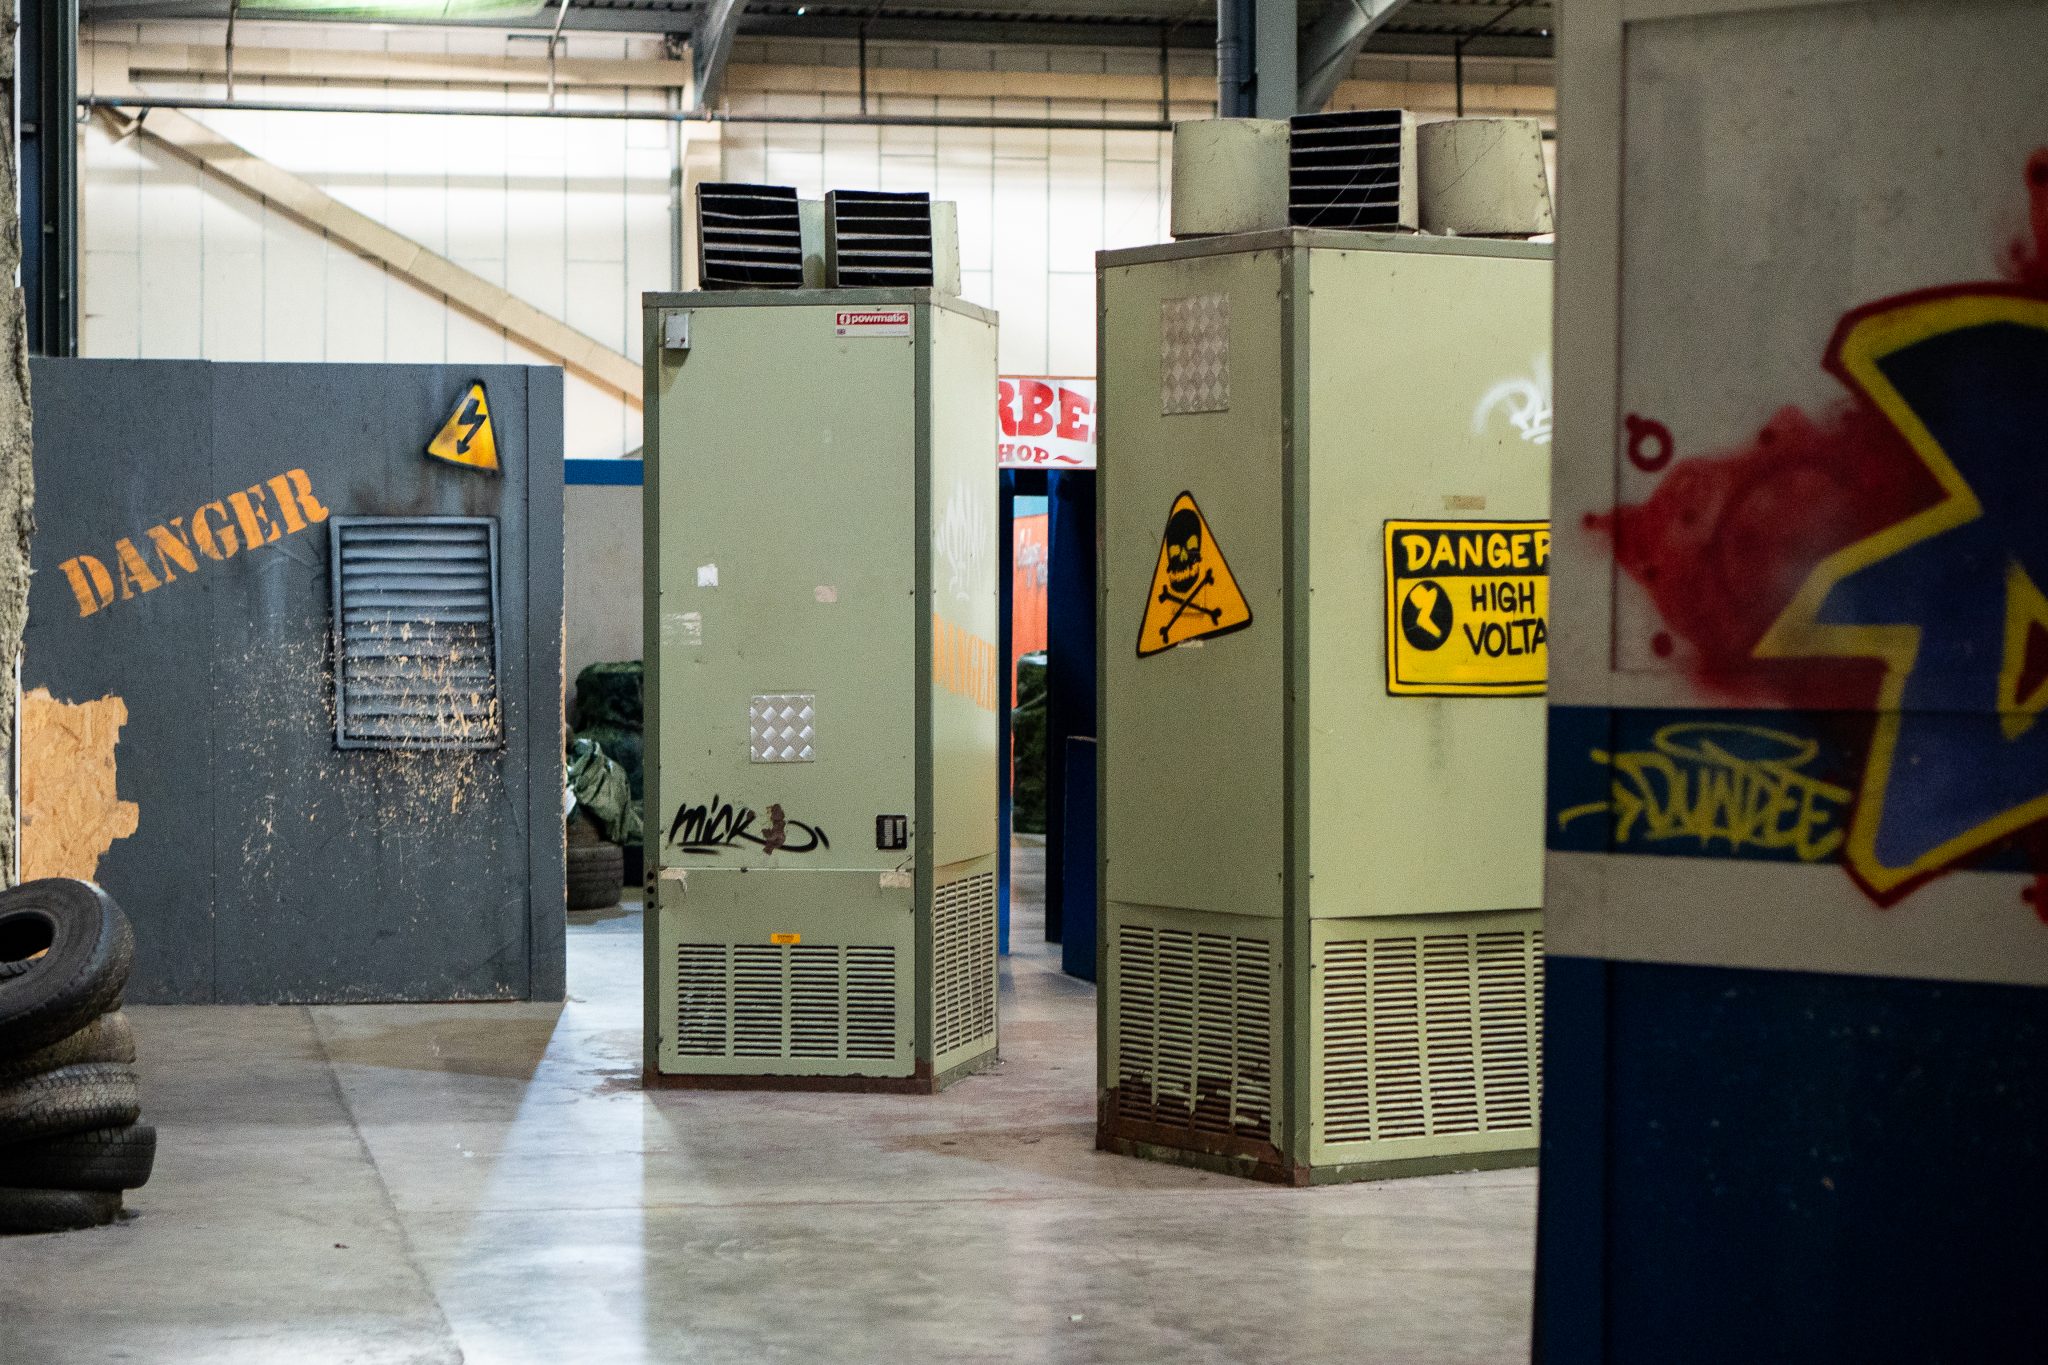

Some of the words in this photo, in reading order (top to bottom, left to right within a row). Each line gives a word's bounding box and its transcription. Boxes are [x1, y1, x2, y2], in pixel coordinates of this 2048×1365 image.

[851, 314, 905, 324] powrmatic
[998, 379, 1097, 443] RBE
[58, 468, 330, 618] DANGER
[1470, 580, 1535, 614] HIGH
